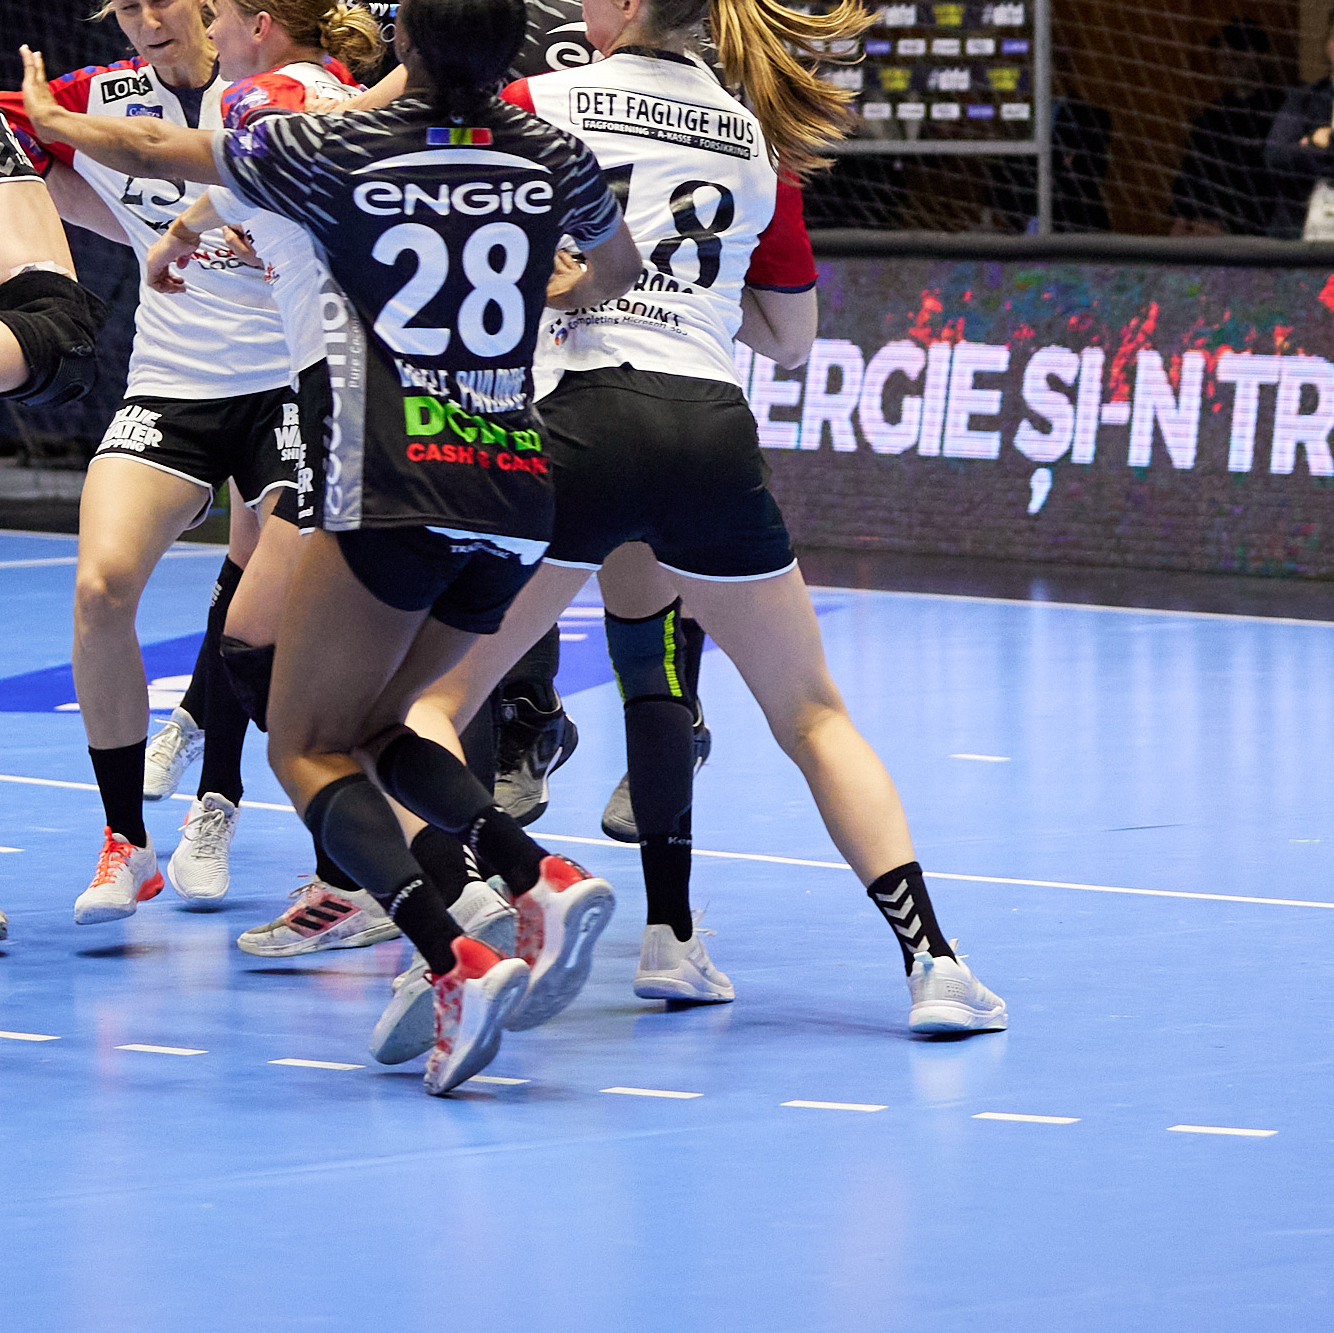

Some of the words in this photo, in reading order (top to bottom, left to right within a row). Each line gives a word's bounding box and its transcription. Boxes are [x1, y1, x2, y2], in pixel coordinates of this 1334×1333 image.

[103, 77, 151, 103] LOLK
[577, 92, 618, 116] DET
[626, 96, 710, 134] FAGLIGE
[718, 115, 755, 145] HUS
[371, 221, 530, 358] 28
[735, 338, 1010, 461] ERGIE
[406, 442, 475, 465] CASH
